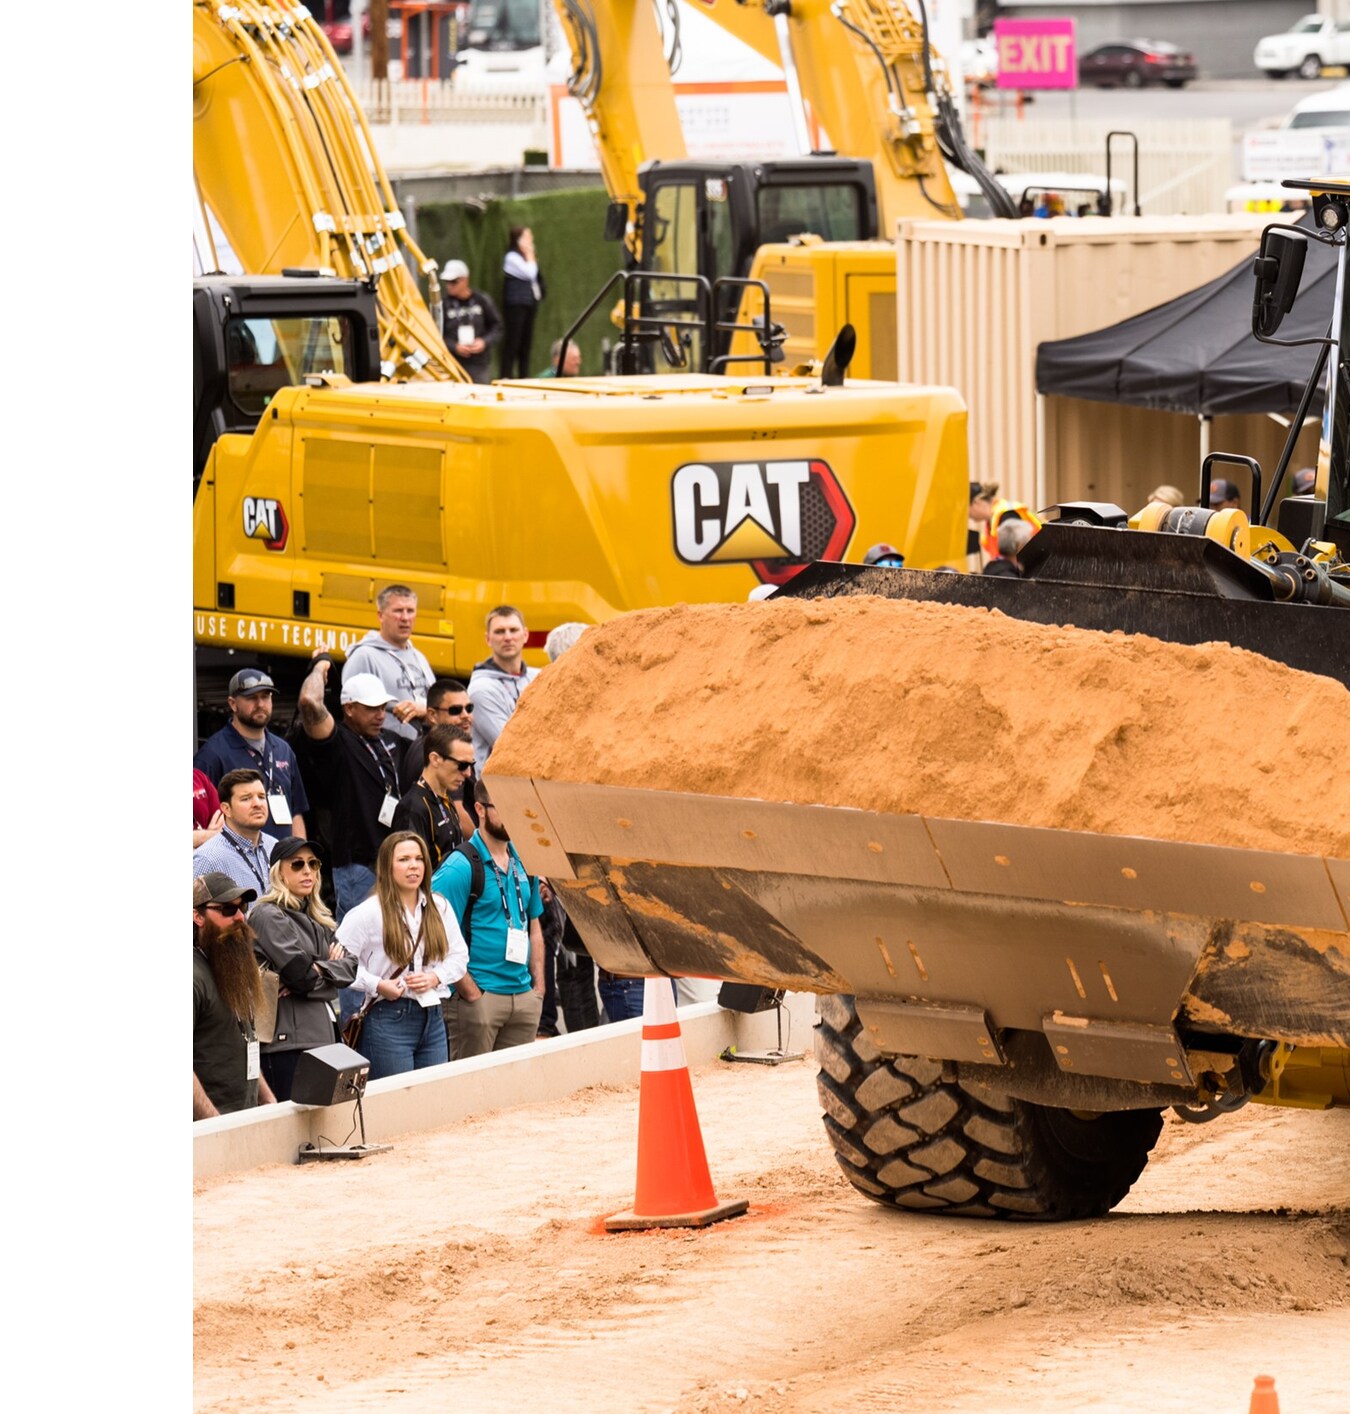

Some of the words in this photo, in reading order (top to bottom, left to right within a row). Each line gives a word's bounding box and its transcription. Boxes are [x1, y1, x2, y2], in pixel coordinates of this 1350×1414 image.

[1000, 35, 1070, 73] EXIT
[243, 496, 277, 540] CAT
[673, 461, 810, 562] CAT
[197, 615, 227, 637] USE
